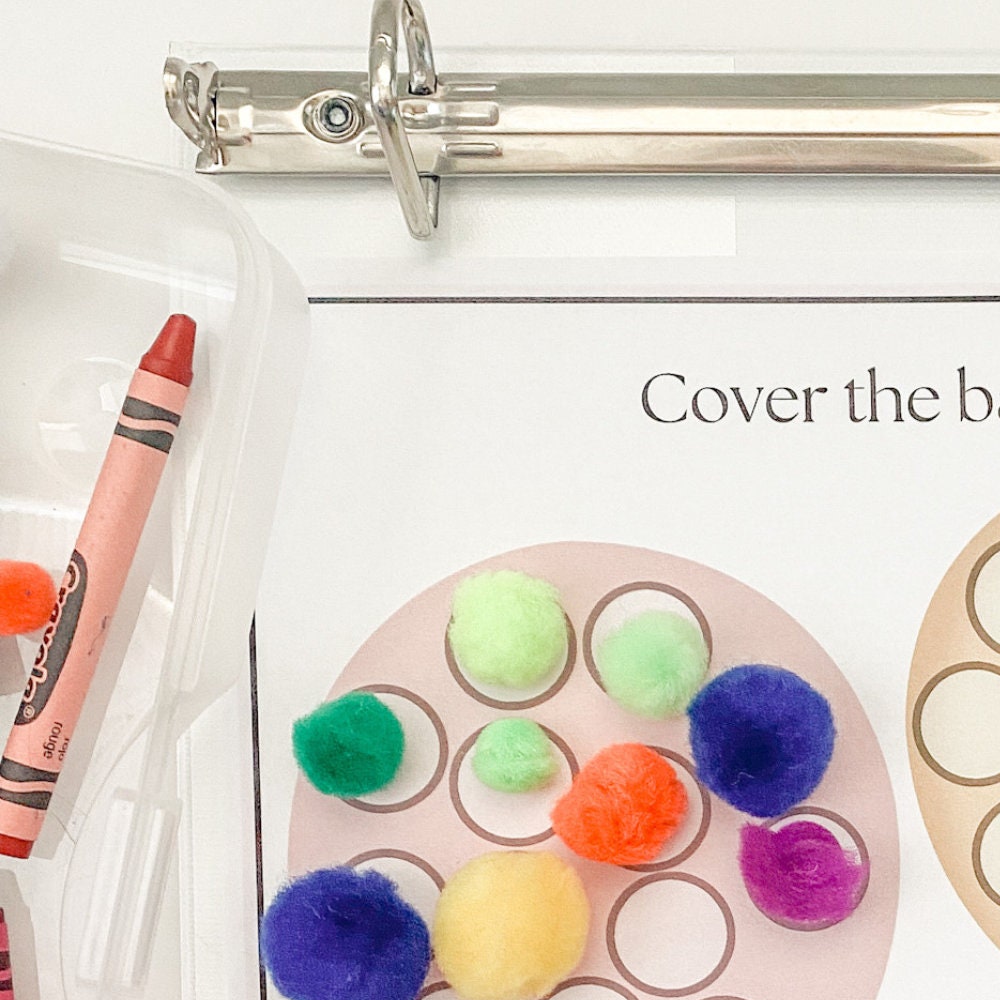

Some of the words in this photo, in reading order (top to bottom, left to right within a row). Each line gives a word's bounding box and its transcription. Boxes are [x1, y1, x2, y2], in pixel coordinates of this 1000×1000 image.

[641, 371, 828, 424] Cover
[843, 366, 940, 423] the
[43, 721, 64, 760] rouge
